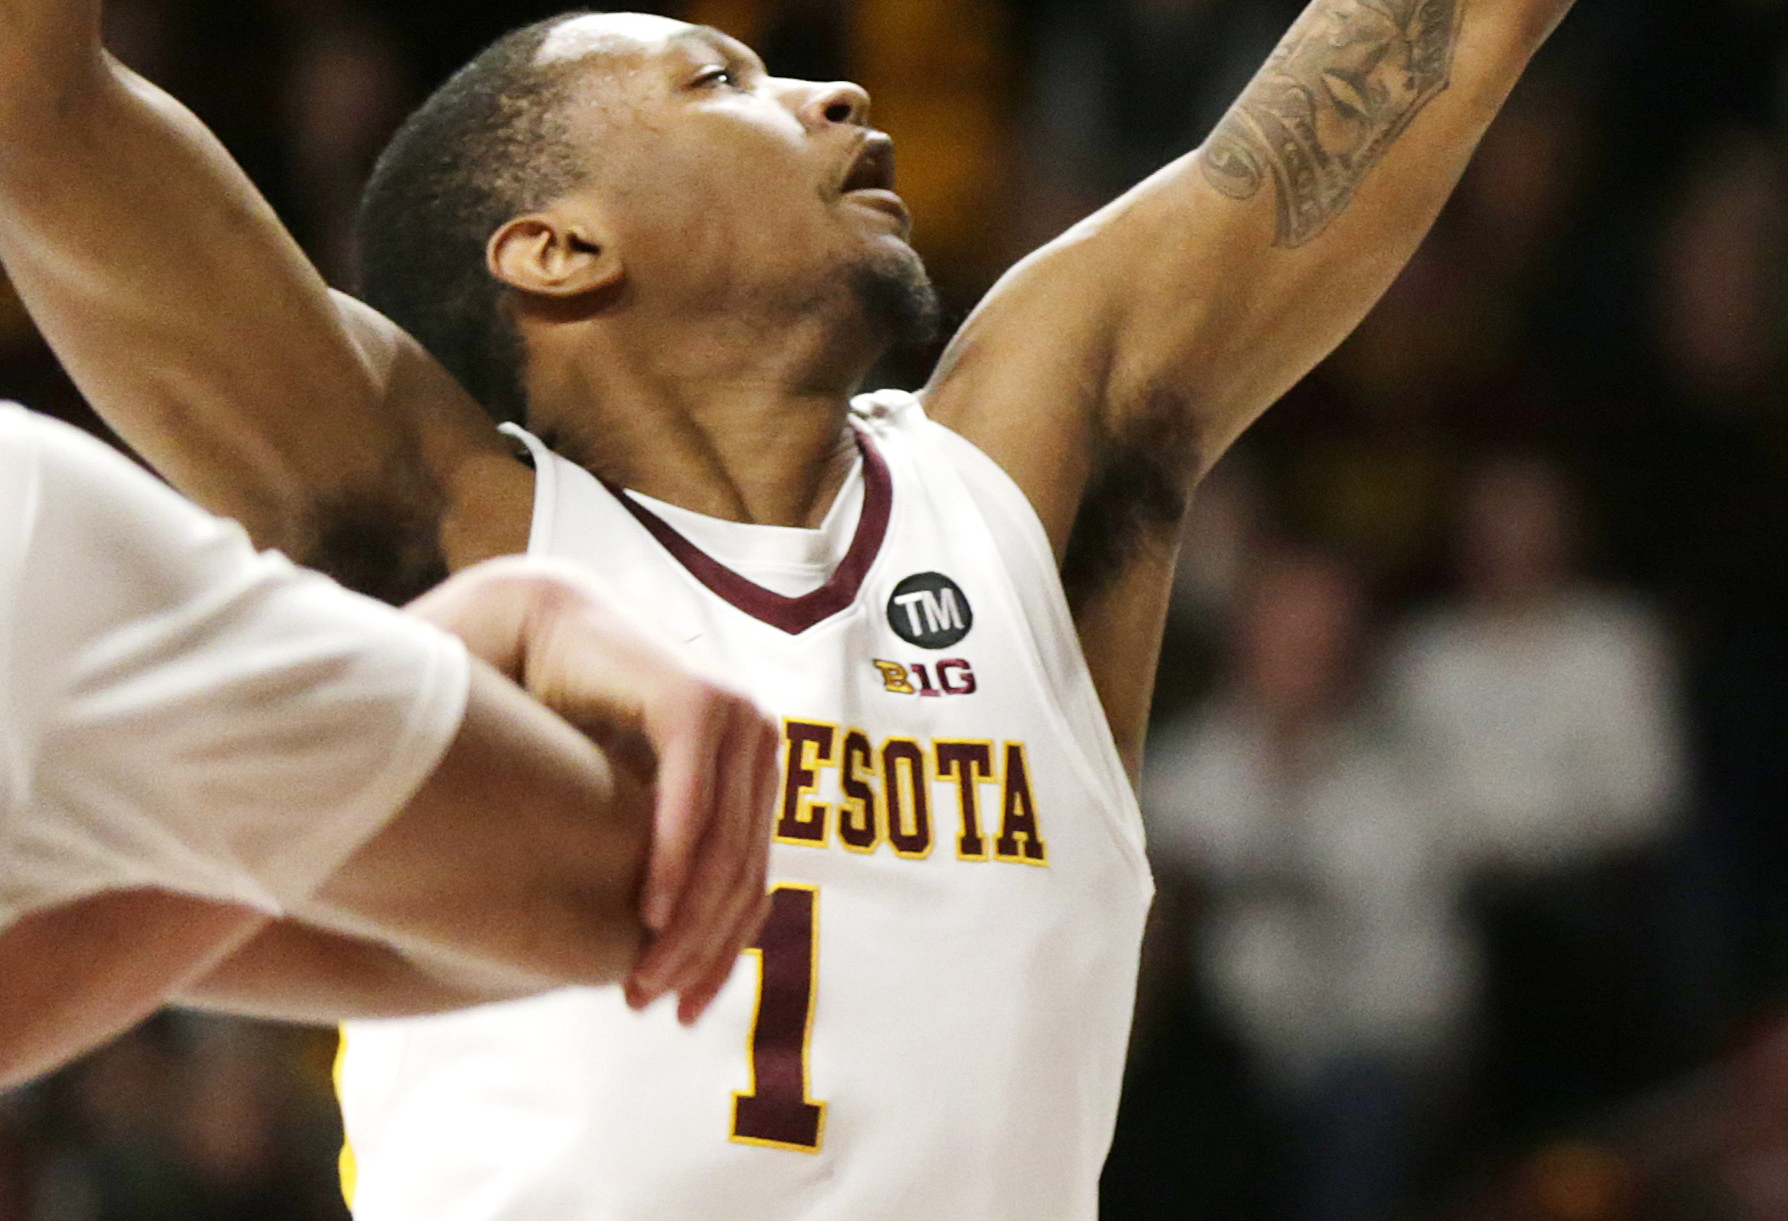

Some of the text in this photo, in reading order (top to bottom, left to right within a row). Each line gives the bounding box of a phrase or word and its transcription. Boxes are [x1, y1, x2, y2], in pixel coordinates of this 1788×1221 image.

[894, 587, 964, 637] TM
[773, 716, 1049, 866] ESOTA
[729, 881, 826, 1155] 1
